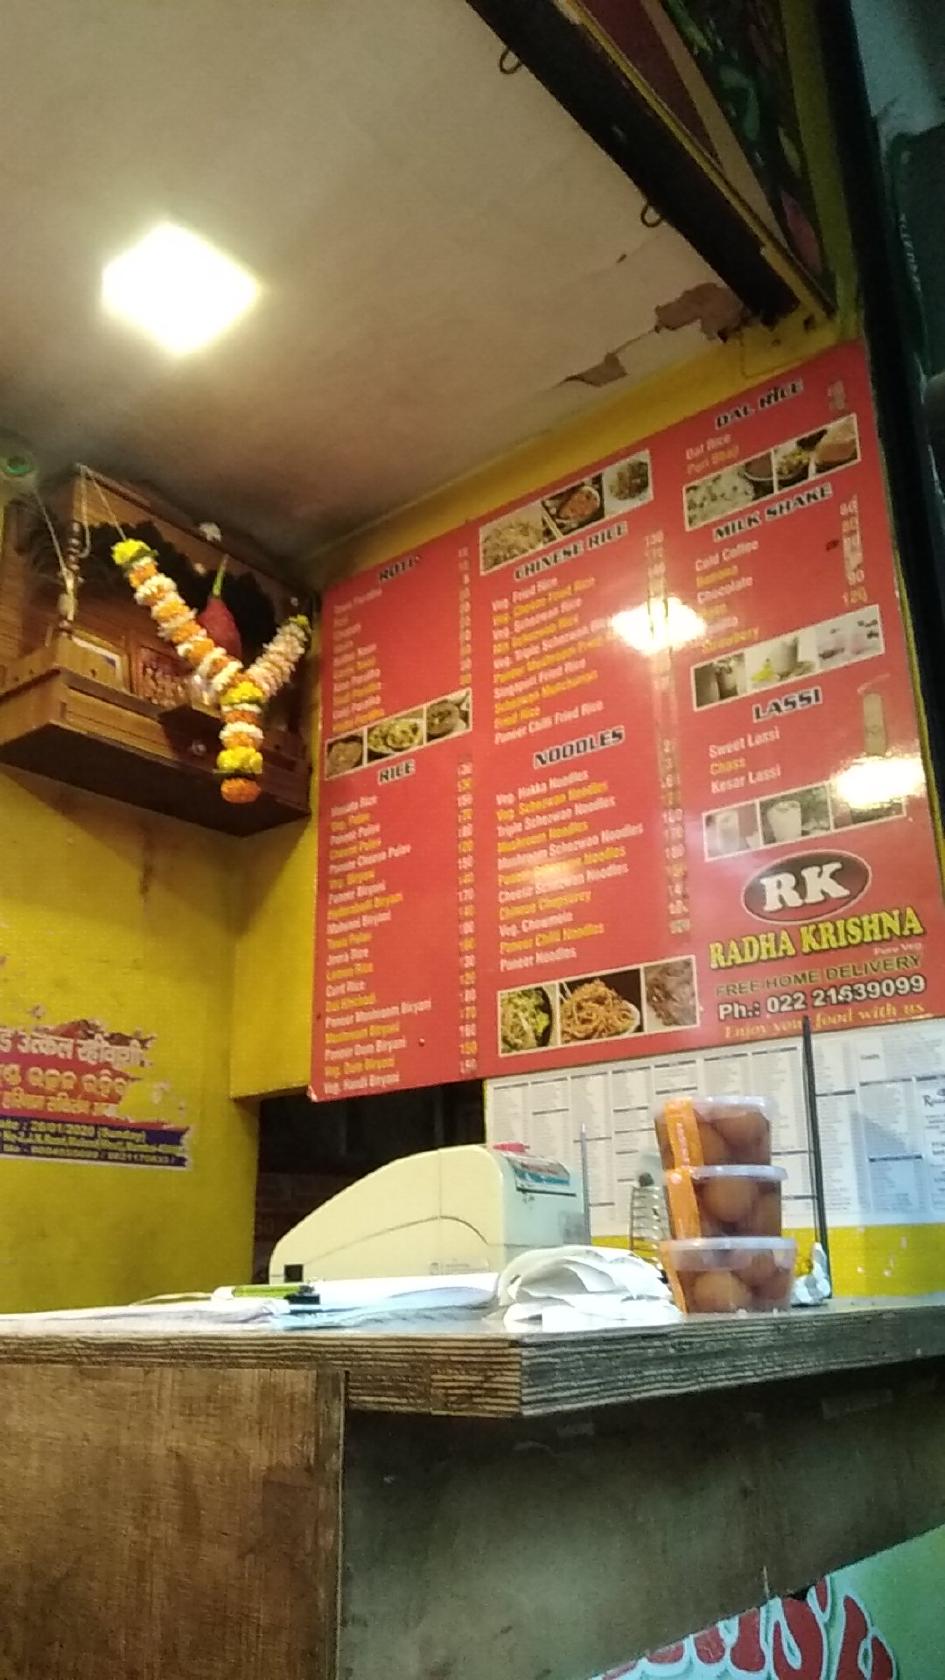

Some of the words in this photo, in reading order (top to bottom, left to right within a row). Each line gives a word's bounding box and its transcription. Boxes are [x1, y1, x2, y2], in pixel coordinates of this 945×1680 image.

[715, 404, 751, 430] DAL
[758, 379, 804, 411] RICE
[714, 511, 762, 543] MILK
[764, 484, 832, 521] SHAKE
[514, 540, 583, 582] CHINESE
[587, 520, 628, 551] RICE
[752, 687, 822, 723] LASSI
[532, 725, 625, 771] NOODLES
[709, 738, 745, 758] Sweet
[377, 758, 417, 786] RICE
[710, 776, 745, 794] Kesar
[759, 862, 851, 913] RK
[709, 929, 797, 970] RADHA
[800, 906, 925, 954] KRISHNA
[716, 981, 762, 997] FREE
[765, 970, 819, 989] HOME
[825, 954, 923, 982] DELIVERY
[766, 991, 807, 1015] 022
